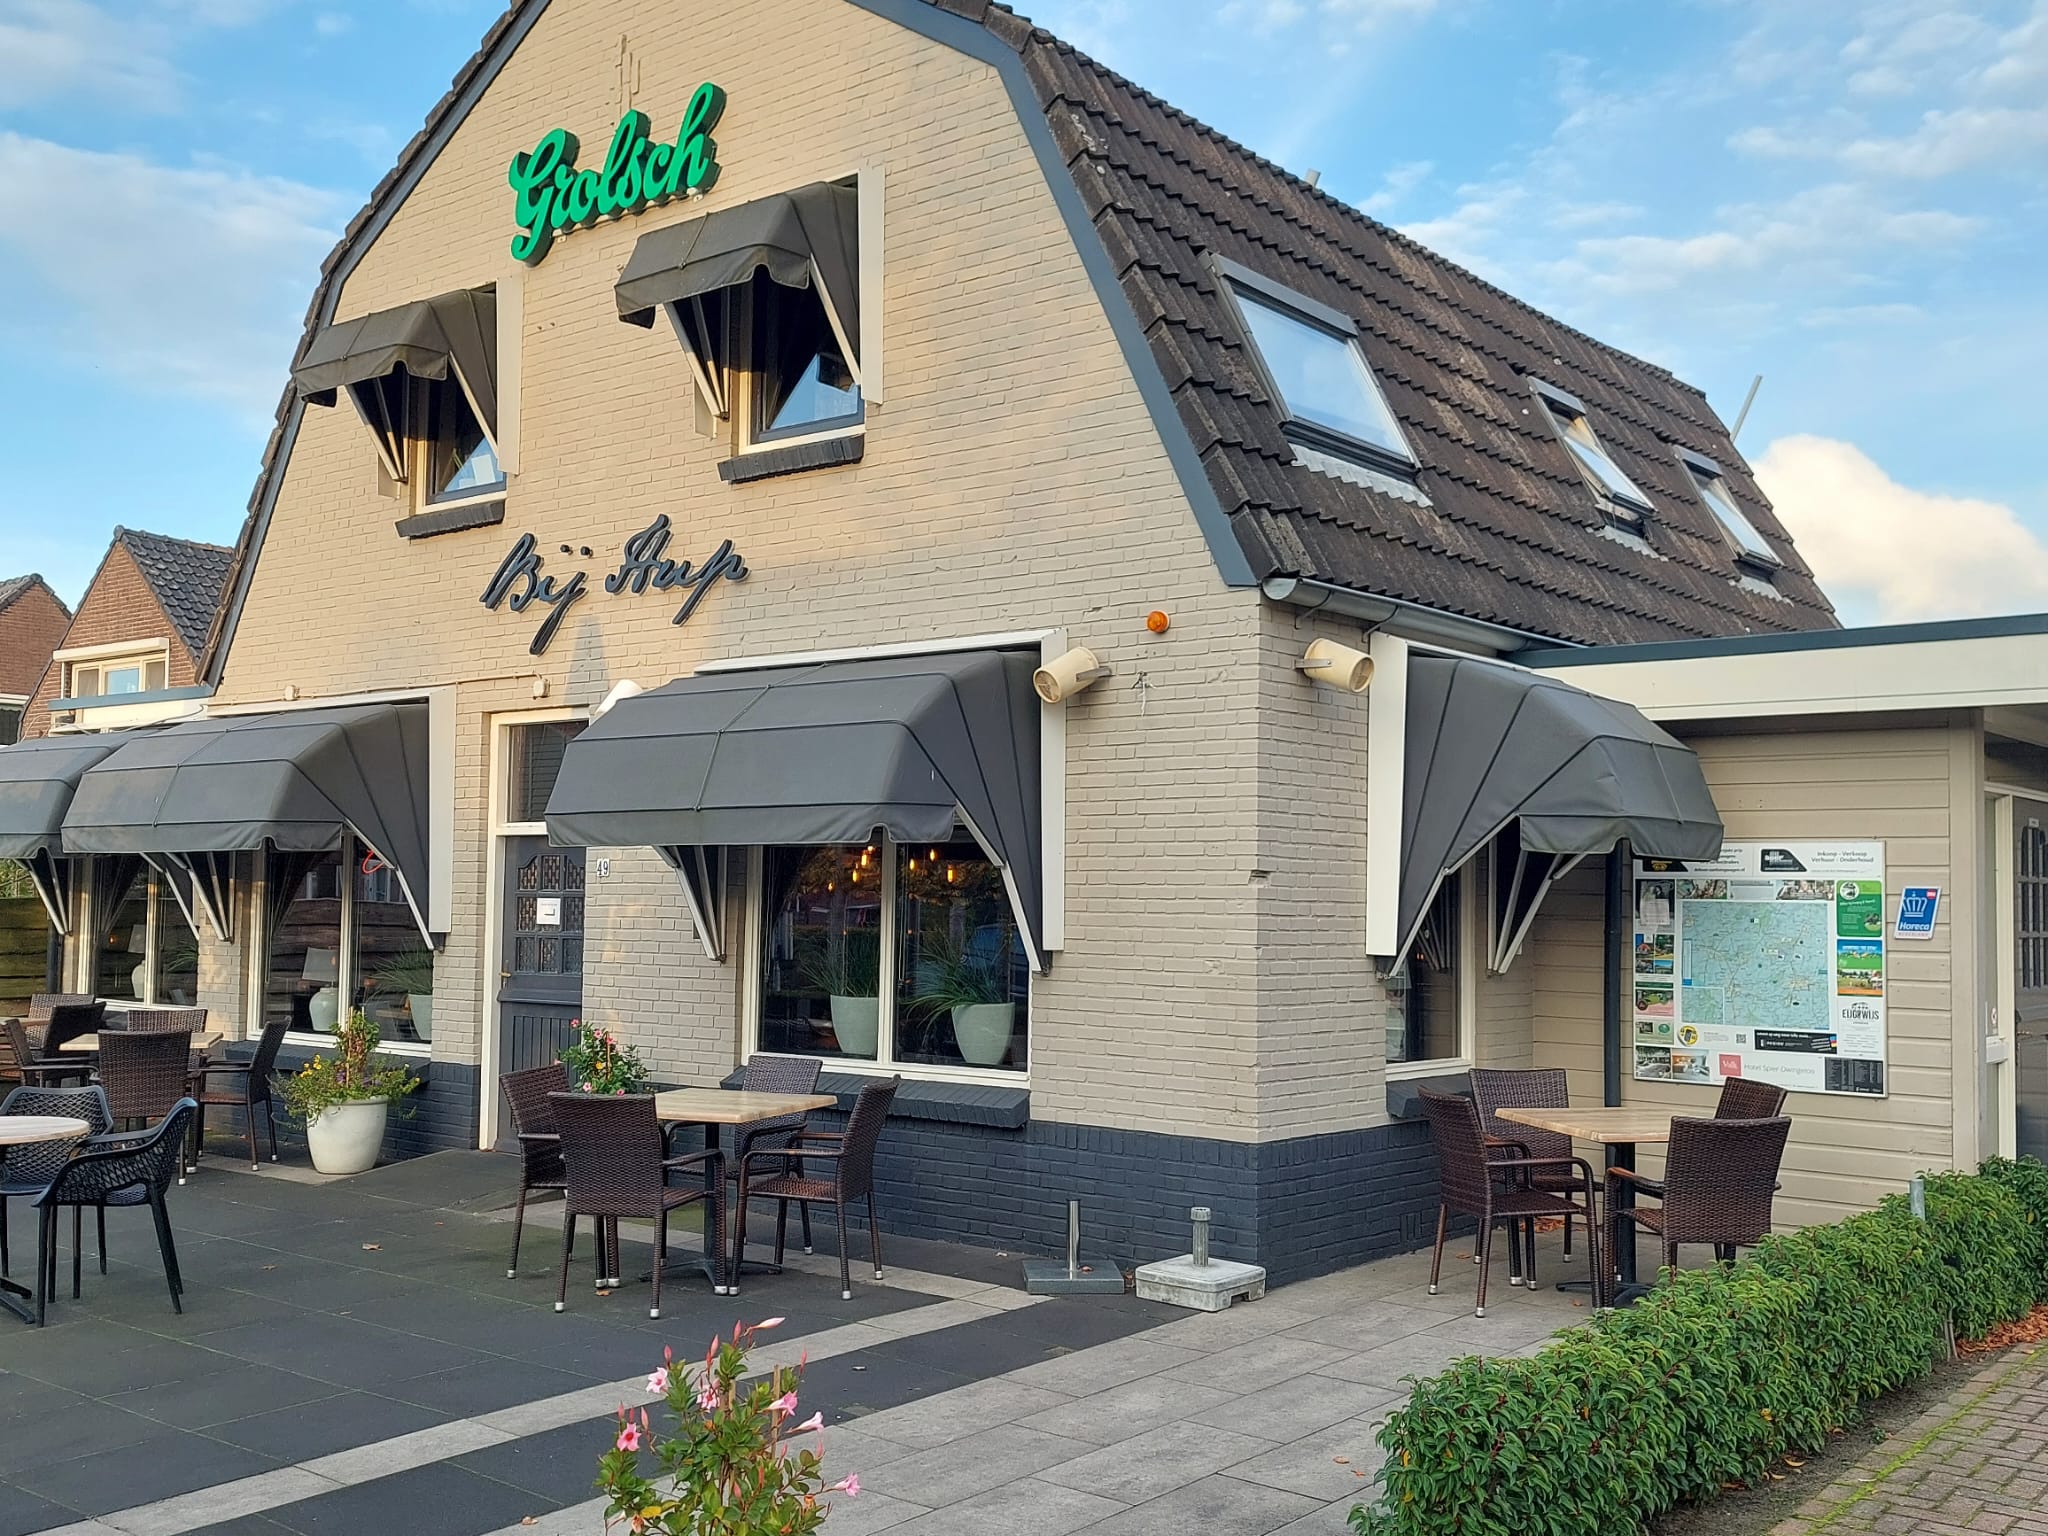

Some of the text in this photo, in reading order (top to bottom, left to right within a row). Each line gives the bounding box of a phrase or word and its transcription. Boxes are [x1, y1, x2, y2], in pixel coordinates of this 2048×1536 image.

[509, 82, 726, 266] Grolsch
[597, 860, 609, 876] 49
[1899, 921, 1930, 931] Horeca
